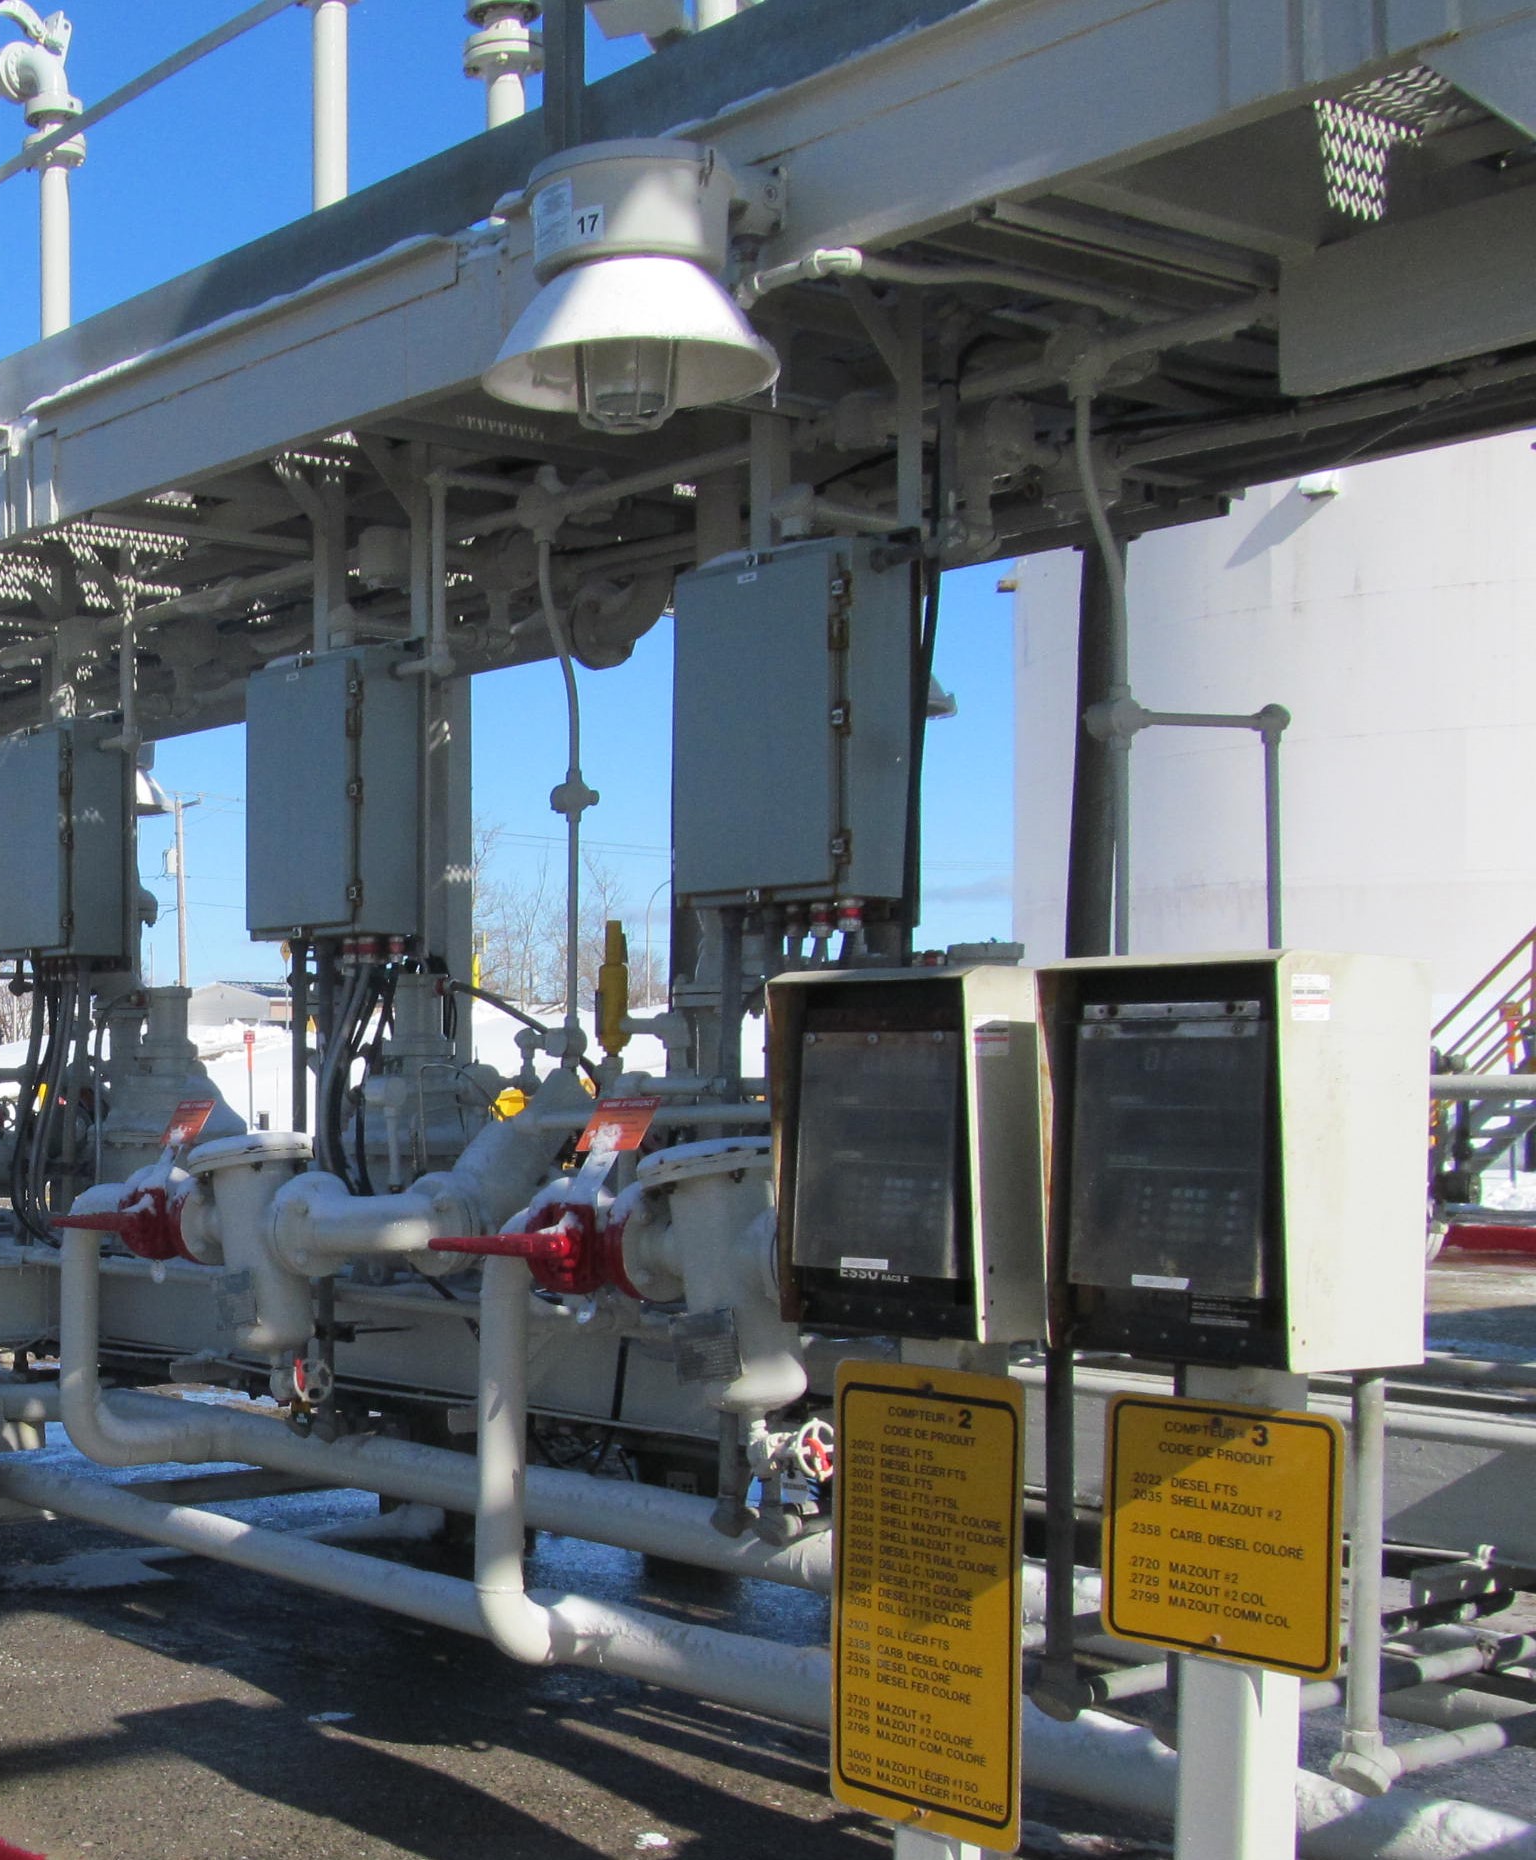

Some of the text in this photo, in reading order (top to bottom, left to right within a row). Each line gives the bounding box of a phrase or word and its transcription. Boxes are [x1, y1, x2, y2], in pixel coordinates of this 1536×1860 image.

[577, 213, 598, 234] 17
[958, 1409, 971, 1428] 2
[883, 1424, 975, 1447] CODE DE PRODUIT
[1164, 1420, 1236, 1440] COMPTEUR
[1251, 1424, 1267, 1447] 3
[880, 1444, 912, 1457] DIESEL
[914, 1449, 933, 1460] FTS
[1158, 1441, 1273, 1466] CODE DE PRODUIT
[880, 1457, 910, 1471] DIESEL
[947, 1468, 966, 1481] FTS
[880, 1472, 911, 1486] DIESEL
[914, 1478, 932, 1490] FTS
[1171, 1477, 1211, 1492] DIESEL
[1214, 1483, 1238, 1496] FTS
[881, 1486, 909, 1500] SHELL
[880, 1501, 908, 1515] SHELL
[1170, 1494, 1207, 1509] SHELL
[1211, 1499, 1263, 1517] MAZOUT
[1267, 1507, 1281, 1520] #2
[880, 1515, 908, 1529] SHELL
[911, 1521, 950, 1537] MAZOUT
[879, 1529, 907, 1544] SHELL
[911, 1535, 949, 1552] MAZOUT
[1208, 1533, 1249, 1550] DIESEL
[1253, 1540, 1304, 1559] COLORÉ
[880, 1544, 909, 1559] DIESEL
[913, 1550, 930, 1563] FTS
[879, 1572, 910, 1588] DIESEL
[912, 1579, 930, 1592] FTS
[1168, 1561, 1221, 1581] MAZOUT
[1224, 1571, 1238, 1583] #2
[878, 1587, 909, 1602] DIESEL
[912, 1594, 930, 1607] FTS
[1168, 1578, 1220, 1597] MAZOUT
[1224, 1588, 1238, 1601] #2
[878, 1601, 895, 1614] DSL
[1168, 1595, 1219, 1615] MAZOUT
[1223, 1605, 1261, 1623] COMM
[1264, 1612, 1291, 1628] COL
[930, 1637, 949, 1651] FTS
[877, 1658, 908, 1675] DIESEL
[907, 1651, 939, 1667] DIESEL
[877, 1672, 908, 1689] DIESEL
[911, 1680, 928, 1694] FER
[876, 1700, 916, 1719] MAZOUT
[876, 1714, 915, 1734] MAZOUT
[876, 1728, 915, 1748] MAZOUT
[876, 1756, 915, 1776] MAZOUT
[876, 1770, 915, 1790] MAZOUT
